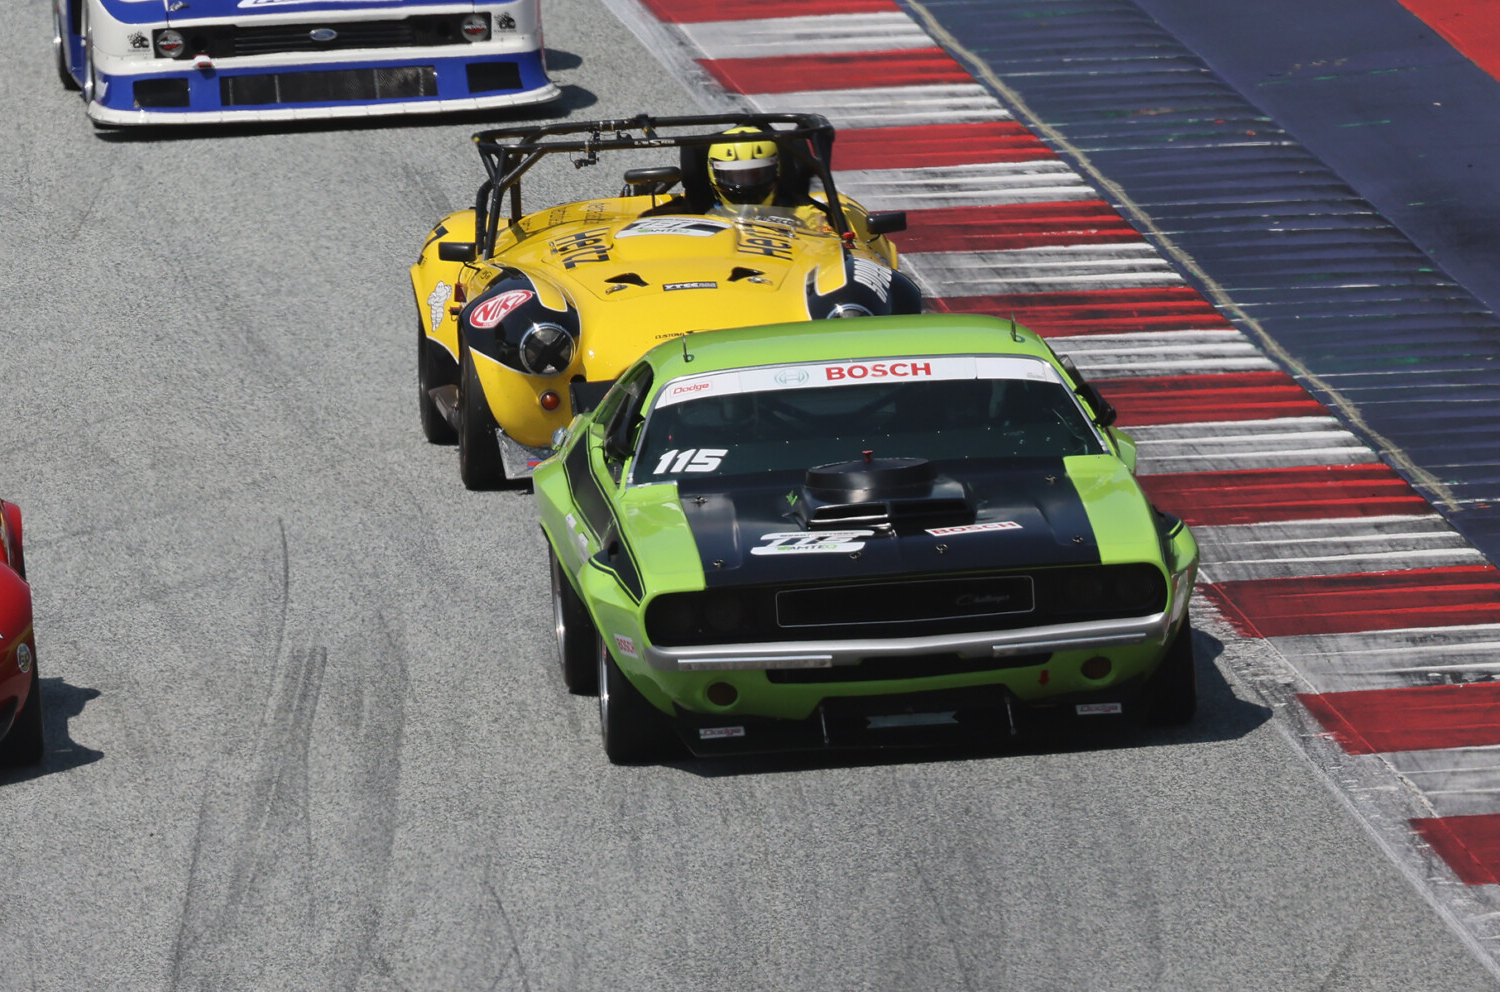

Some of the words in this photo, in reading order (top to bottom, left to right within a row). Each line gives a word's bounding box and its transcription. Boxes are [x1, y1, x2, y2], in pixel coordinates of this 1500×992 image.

[825, 362, 932, 381] BOSCH
[672, 382, 710, 396] Dodge
[652, 448, 729, 475] 115
[931, 521, 1017, 535] BOSCH
